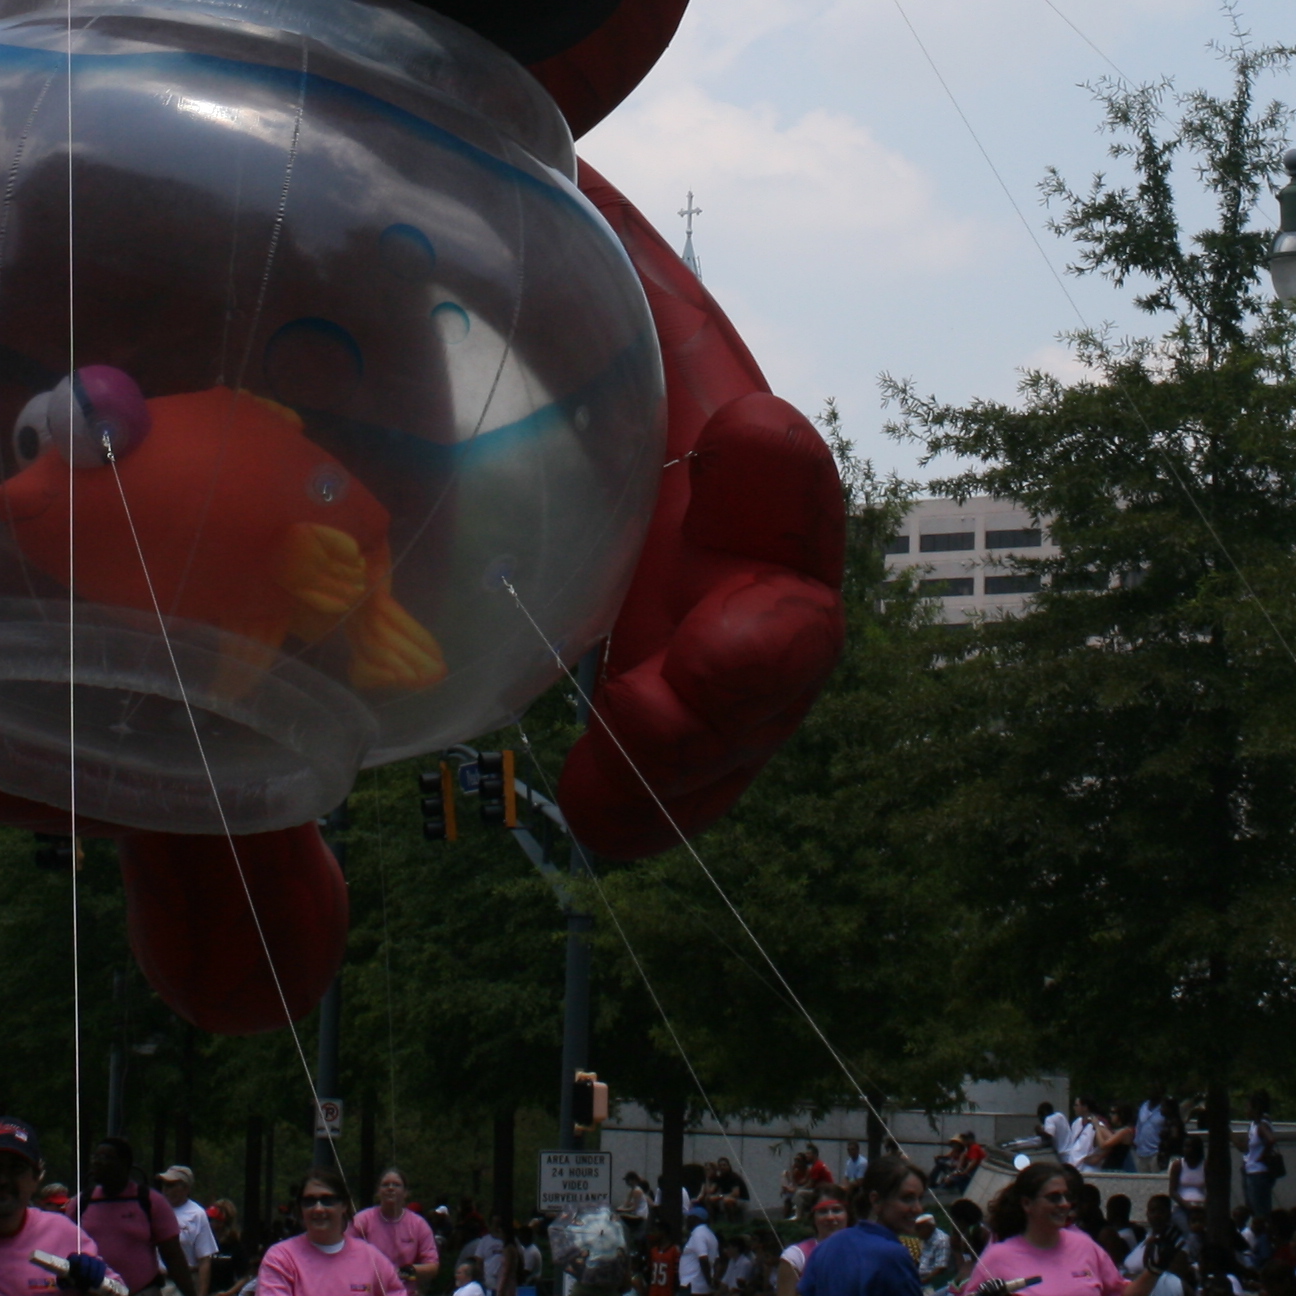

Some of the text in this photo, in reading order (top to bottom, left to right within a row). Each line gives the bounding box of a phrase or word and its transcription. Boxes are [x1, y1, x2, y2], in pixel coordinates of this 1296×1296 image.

[547, 1155, 605, 1164] AREA UNDER
[552, 1168, 599, 1177] 24 HOURS
[562, 1180, 589, 1190] VIDEO
